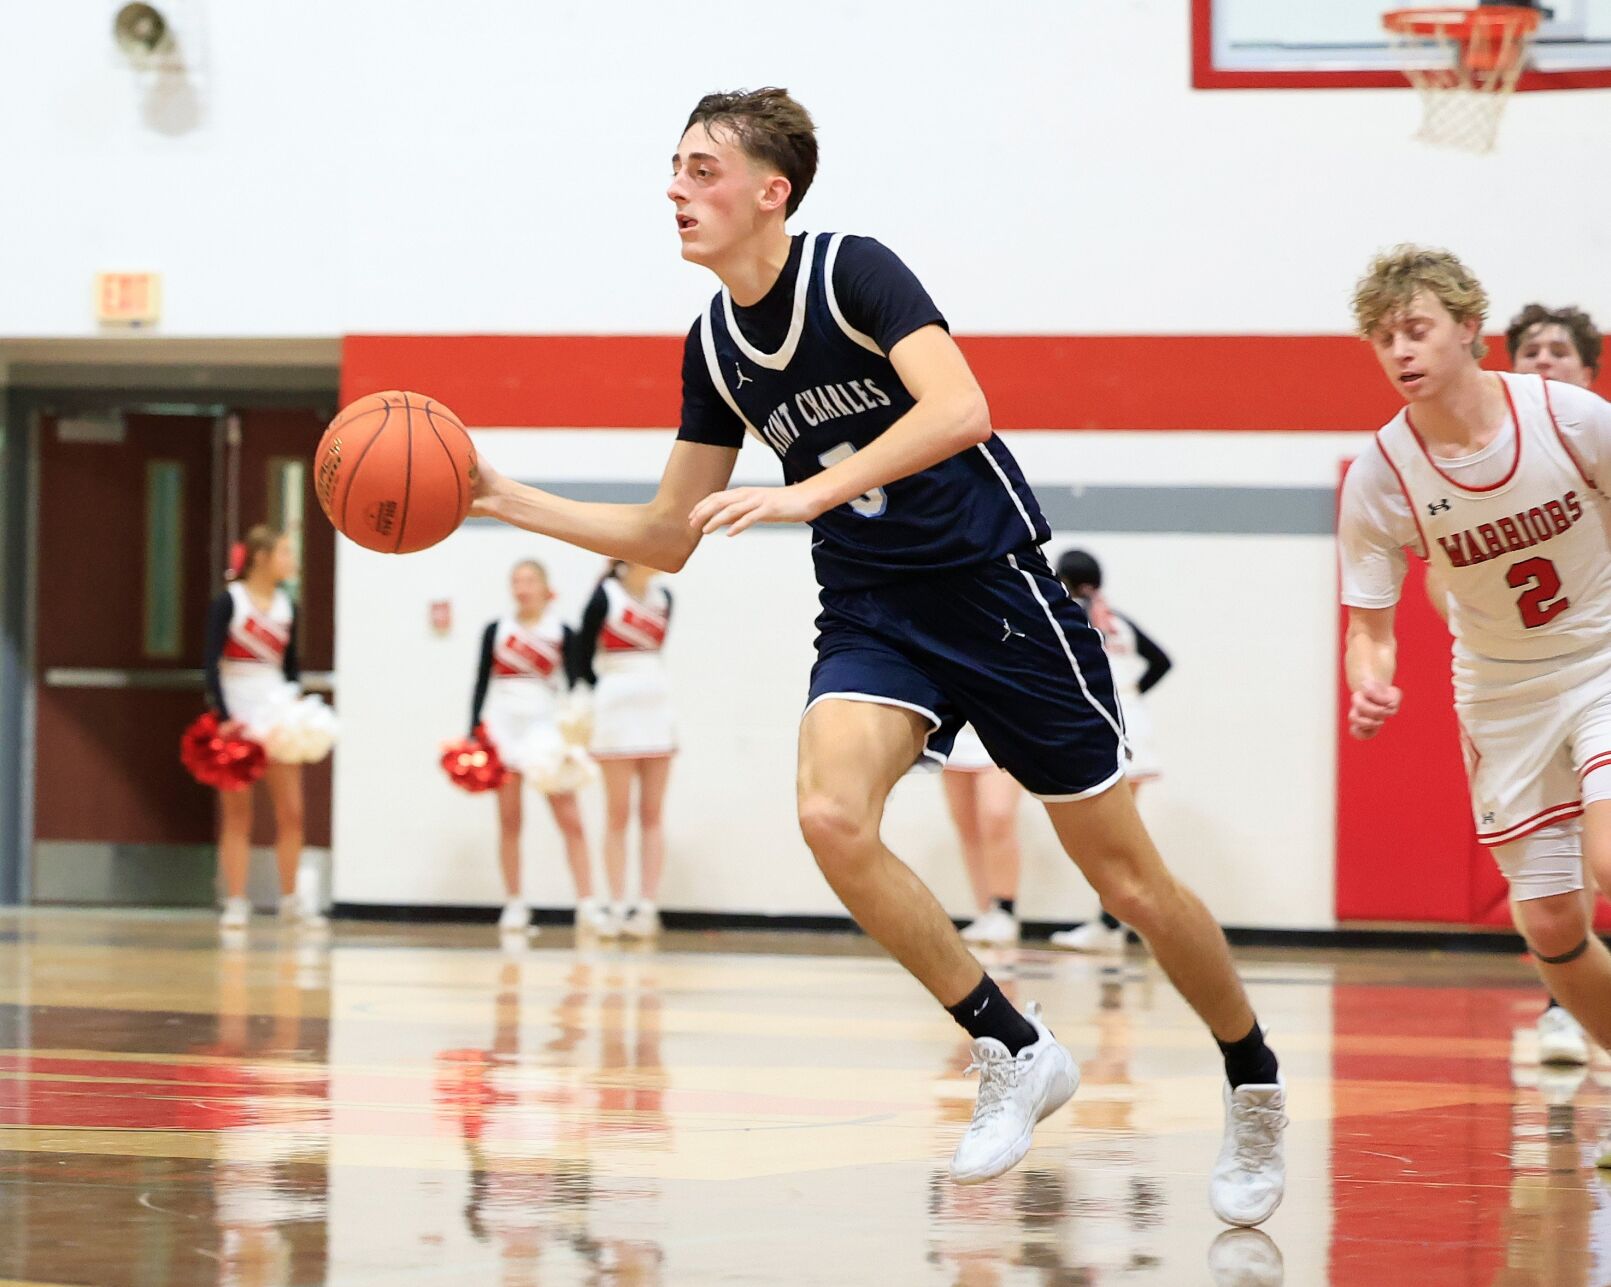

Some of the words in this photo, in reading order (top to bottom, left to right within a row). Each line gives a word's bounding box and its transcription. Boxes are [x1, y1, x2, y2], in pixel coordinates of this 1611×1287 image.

[762, 402, 800, 457] AINT
[794, 378, 891, 427] CHARLES
[1437, 490, 1584, 567] WARRIORS
[1505, 556, 1570, 629] 2
